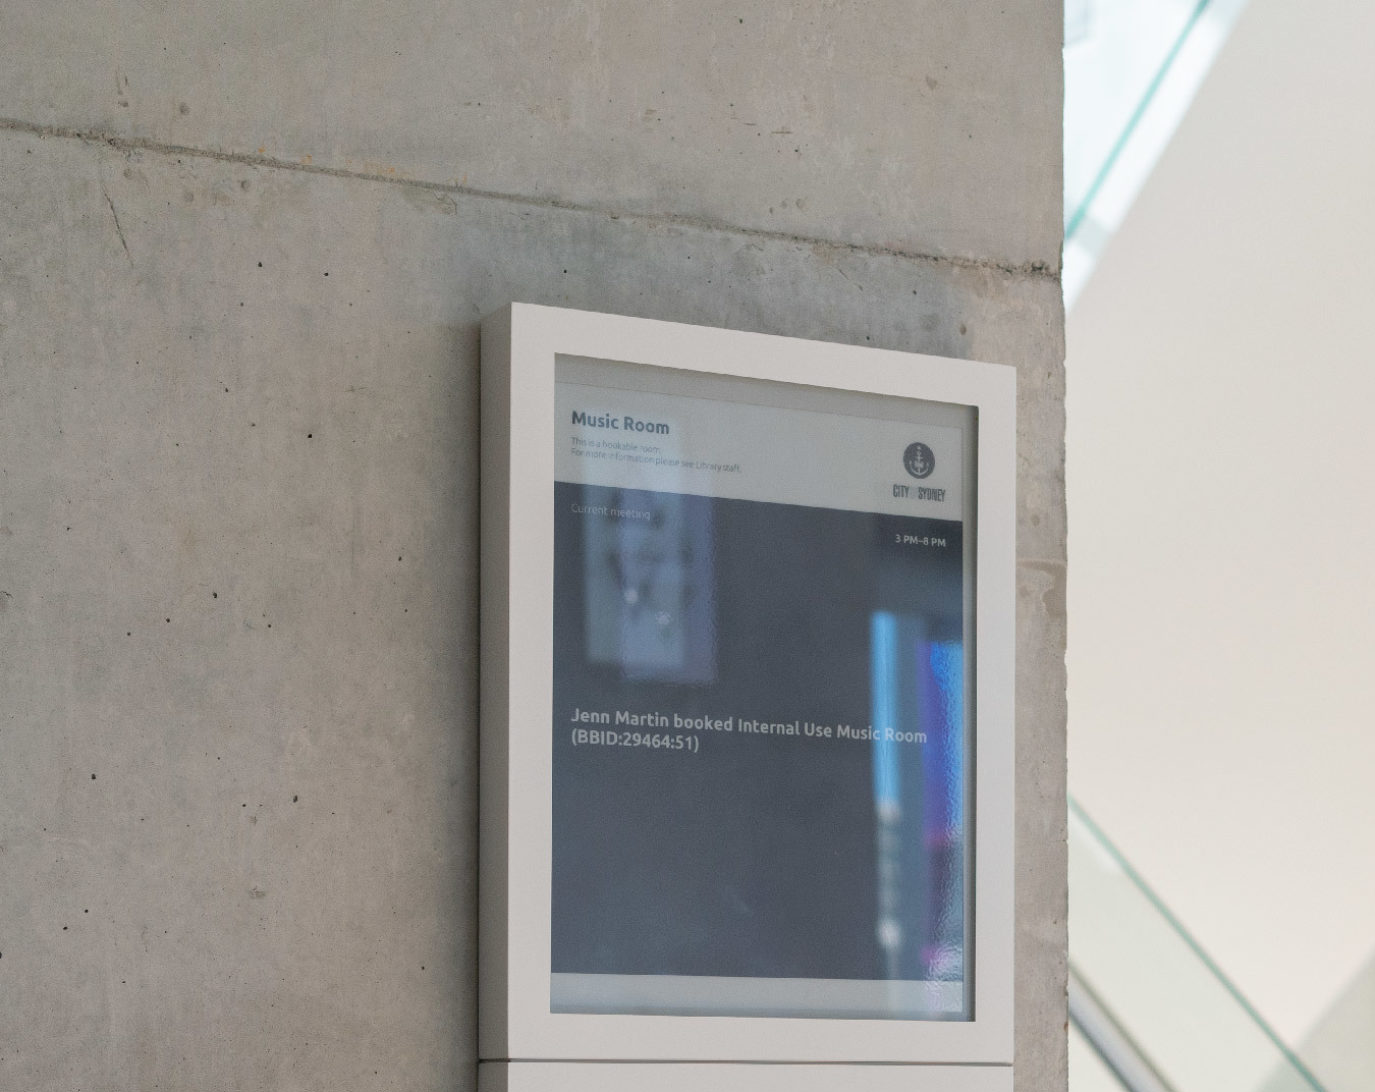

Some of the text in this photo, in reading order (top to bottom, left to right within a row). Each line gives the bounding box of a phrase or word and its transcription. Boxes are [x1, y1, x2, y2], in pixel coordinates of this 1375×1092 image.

[571, 410, 670, 435] Music Room
[571, 437, 587, 447] This
[893, 484, 910, 498] CITY
[918, 486, 946, 502] SYDNEY
[570, 503, 651, 521] Current meeting
[895, 534, 901, 543] 3
[931, 538, 947, 547] PM
[571, 708, 928, 744] Jenn Martin booked Internal Use Music Room
[571, 728, 700, 752] (BBID:29464:51)
